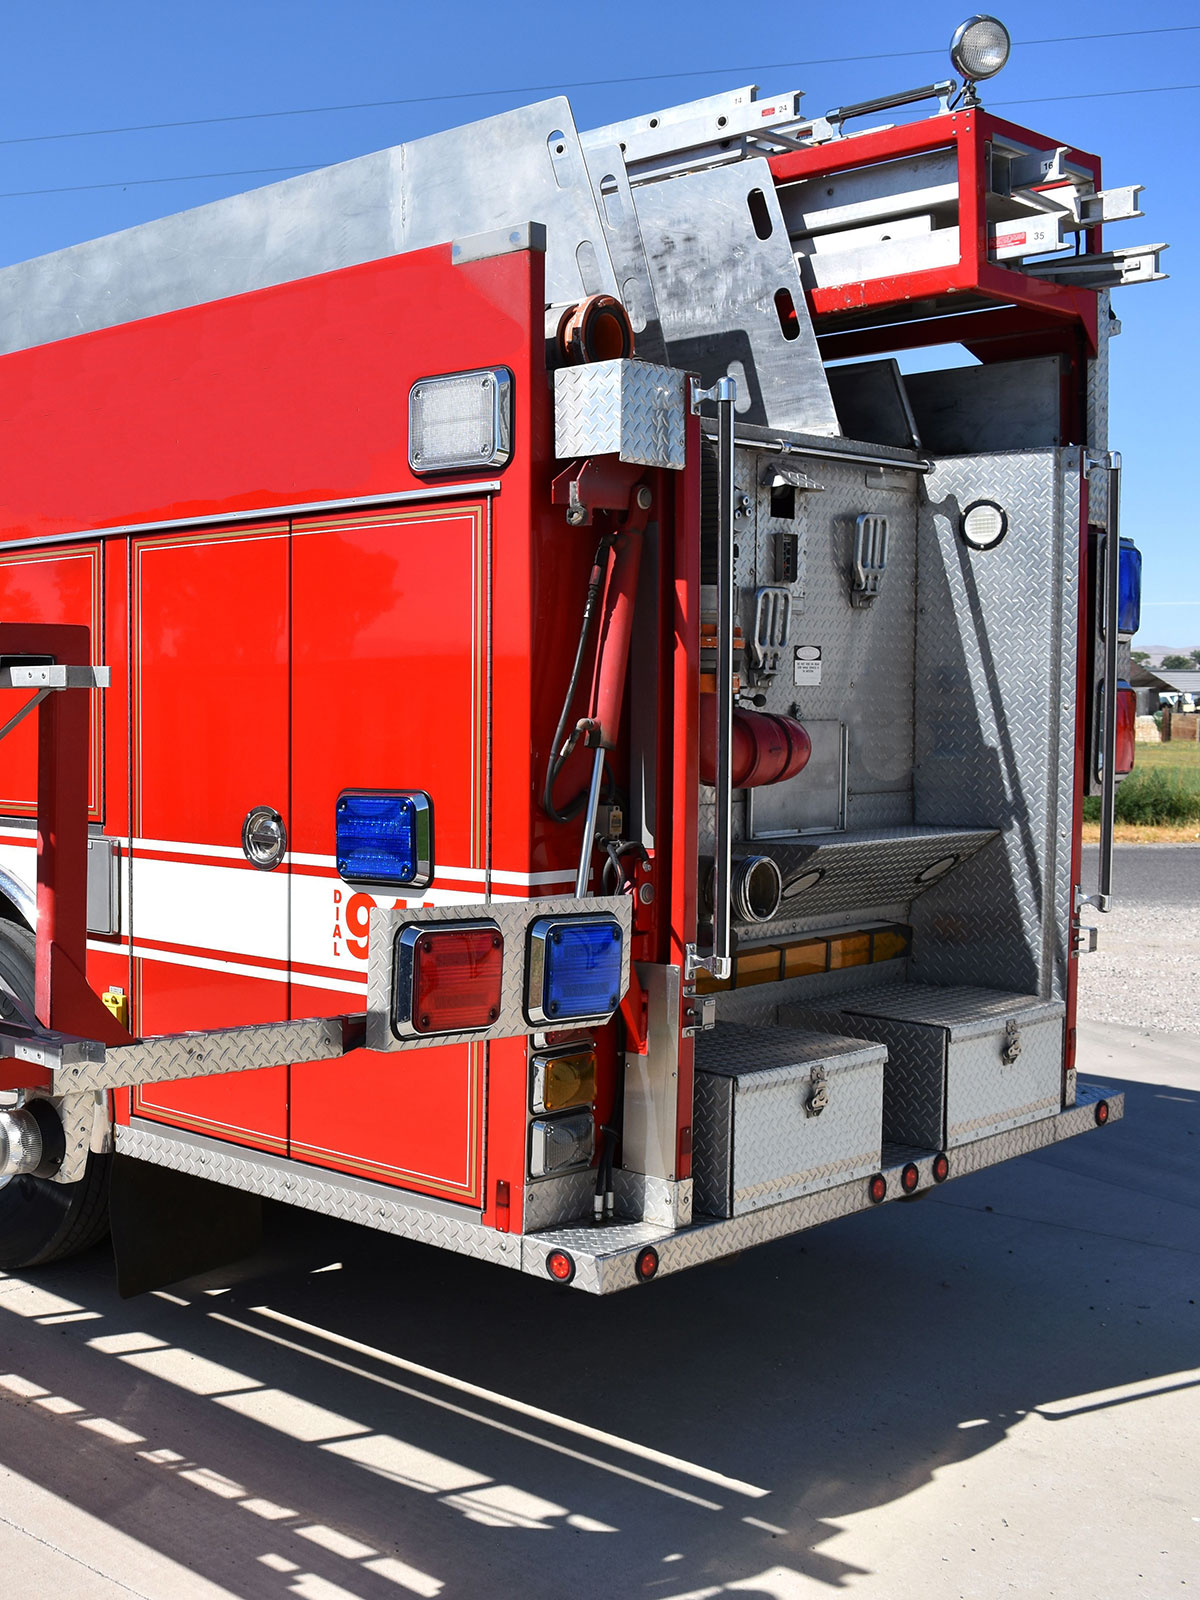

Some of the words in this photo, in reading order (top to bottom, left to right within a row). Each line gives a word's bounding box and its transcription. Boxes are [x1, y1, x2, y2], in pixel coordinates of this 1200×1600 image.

[779, 104, 787, 113] 24
[1044, 161, 1053, 169] 16
[1033, 232, 1044, 240] 35
[333, 889, 342, 956] DIAL
